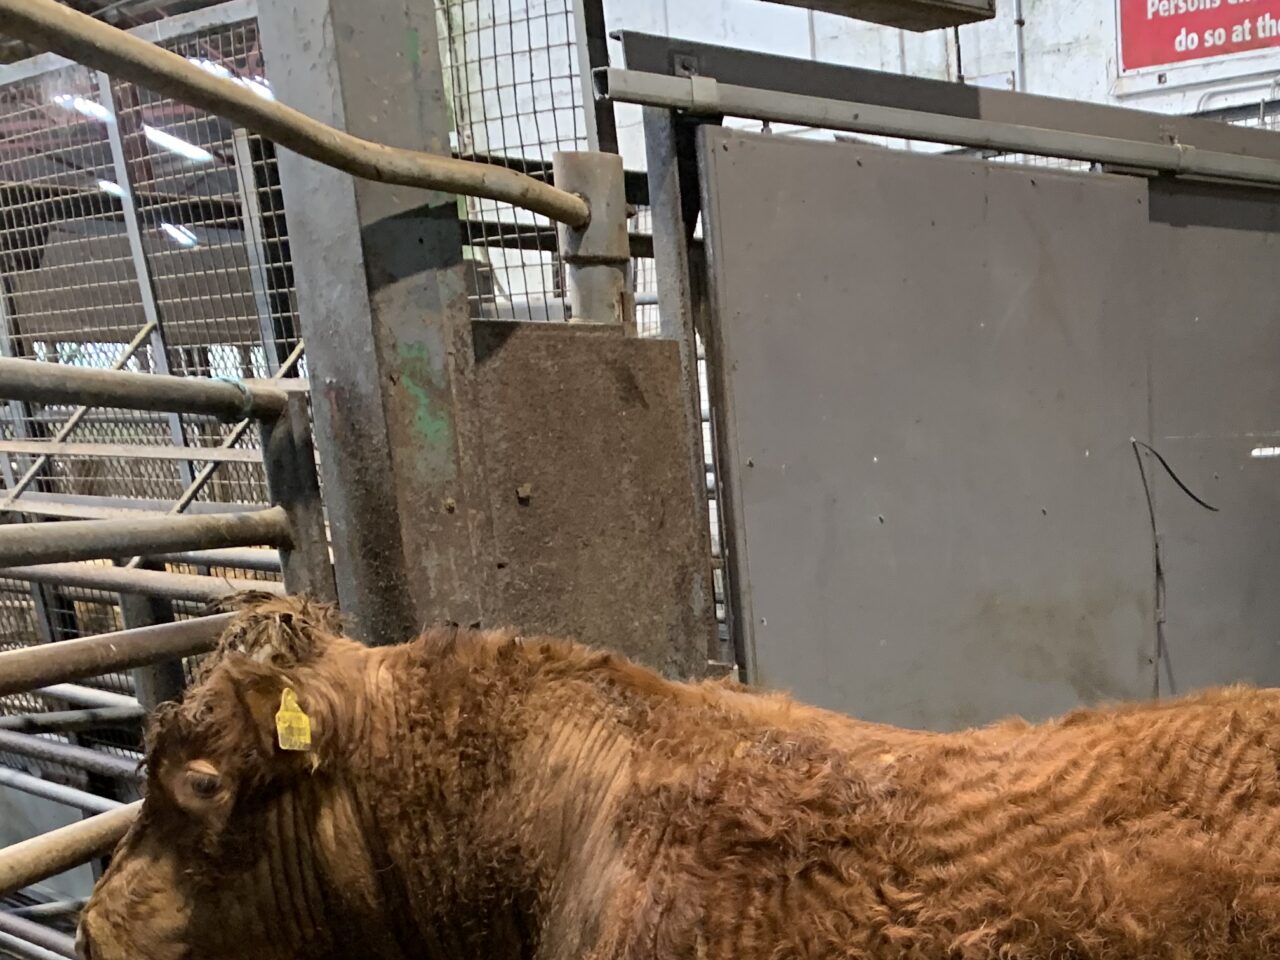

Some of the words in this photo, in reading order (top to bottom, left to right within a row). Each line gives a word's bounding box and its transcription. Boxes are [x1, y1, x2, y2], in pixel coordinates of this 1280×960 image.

[1147, 0, 1221, 20] Persons
[1174, 27, 1198, 52] do
[1204, 28, 1226, 46] so
[1231, 19, 1252, 43] at
